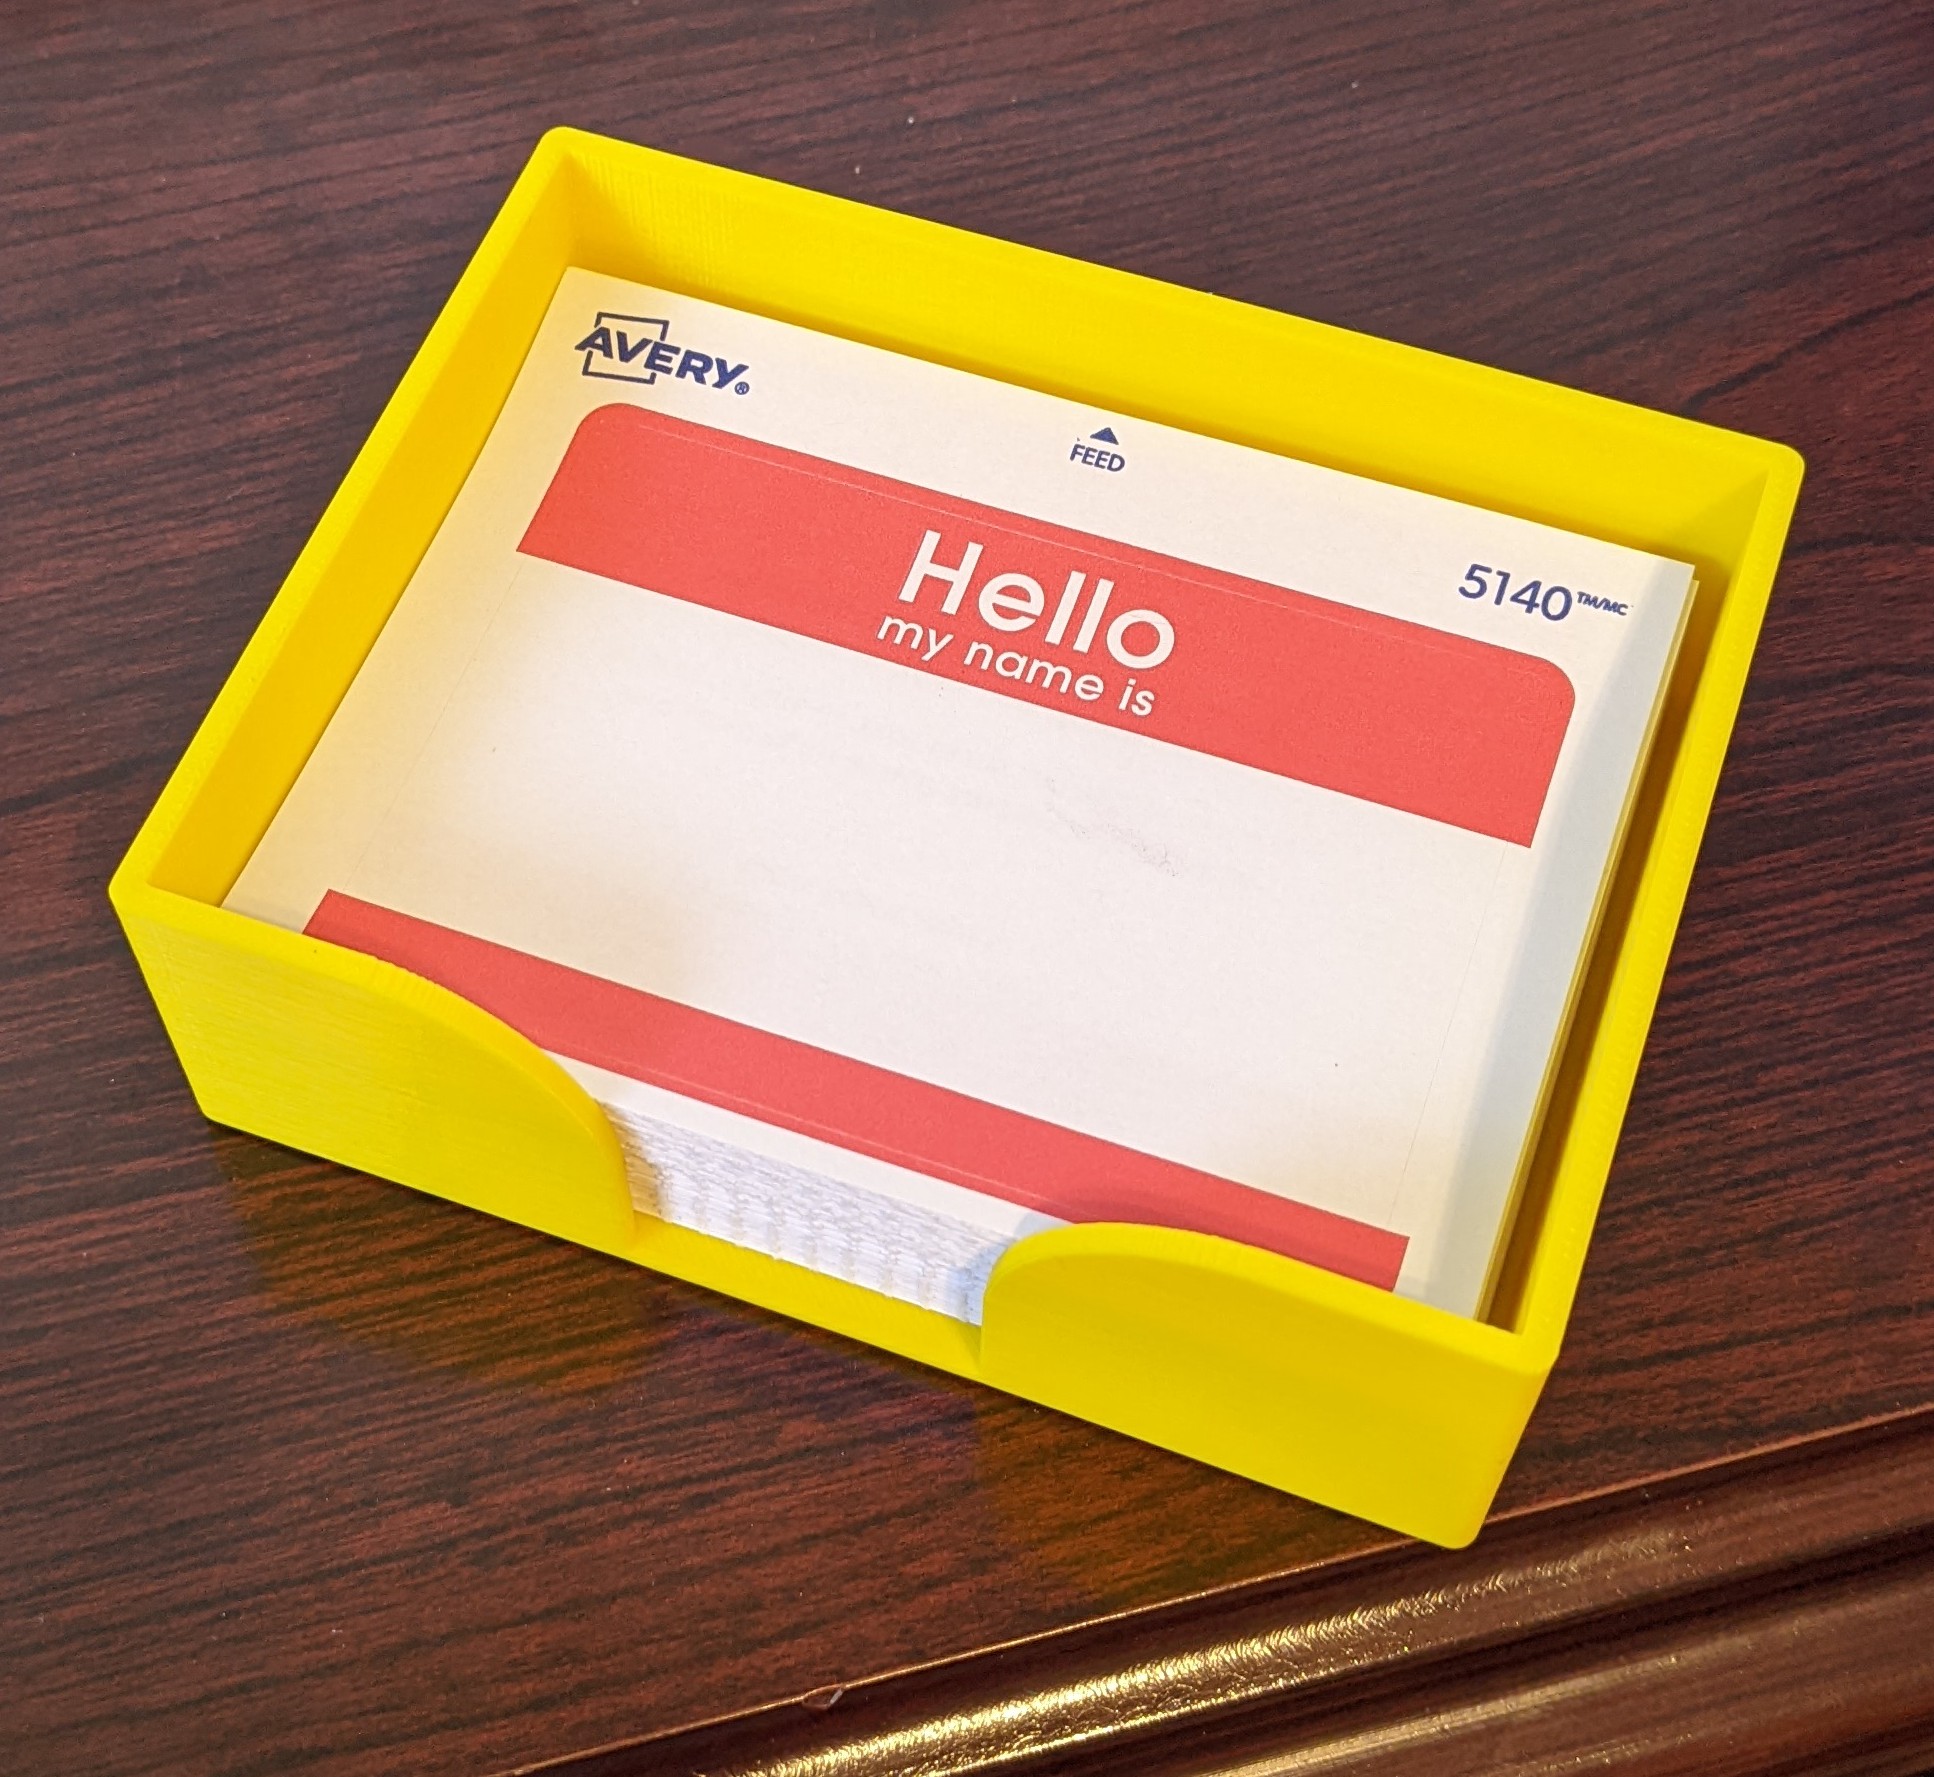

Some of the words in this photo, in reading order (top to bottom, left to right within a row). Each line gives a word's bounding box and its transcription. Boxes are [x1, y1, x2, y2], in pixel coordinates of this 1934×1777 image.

[1069, 443, 1126, 472] FEED
[898, 528, 1175, 669] Hello
[876, 615, 954, 661] my
[963, 641, 1104, 701] name
[1118, 678, 1155, 716] is
